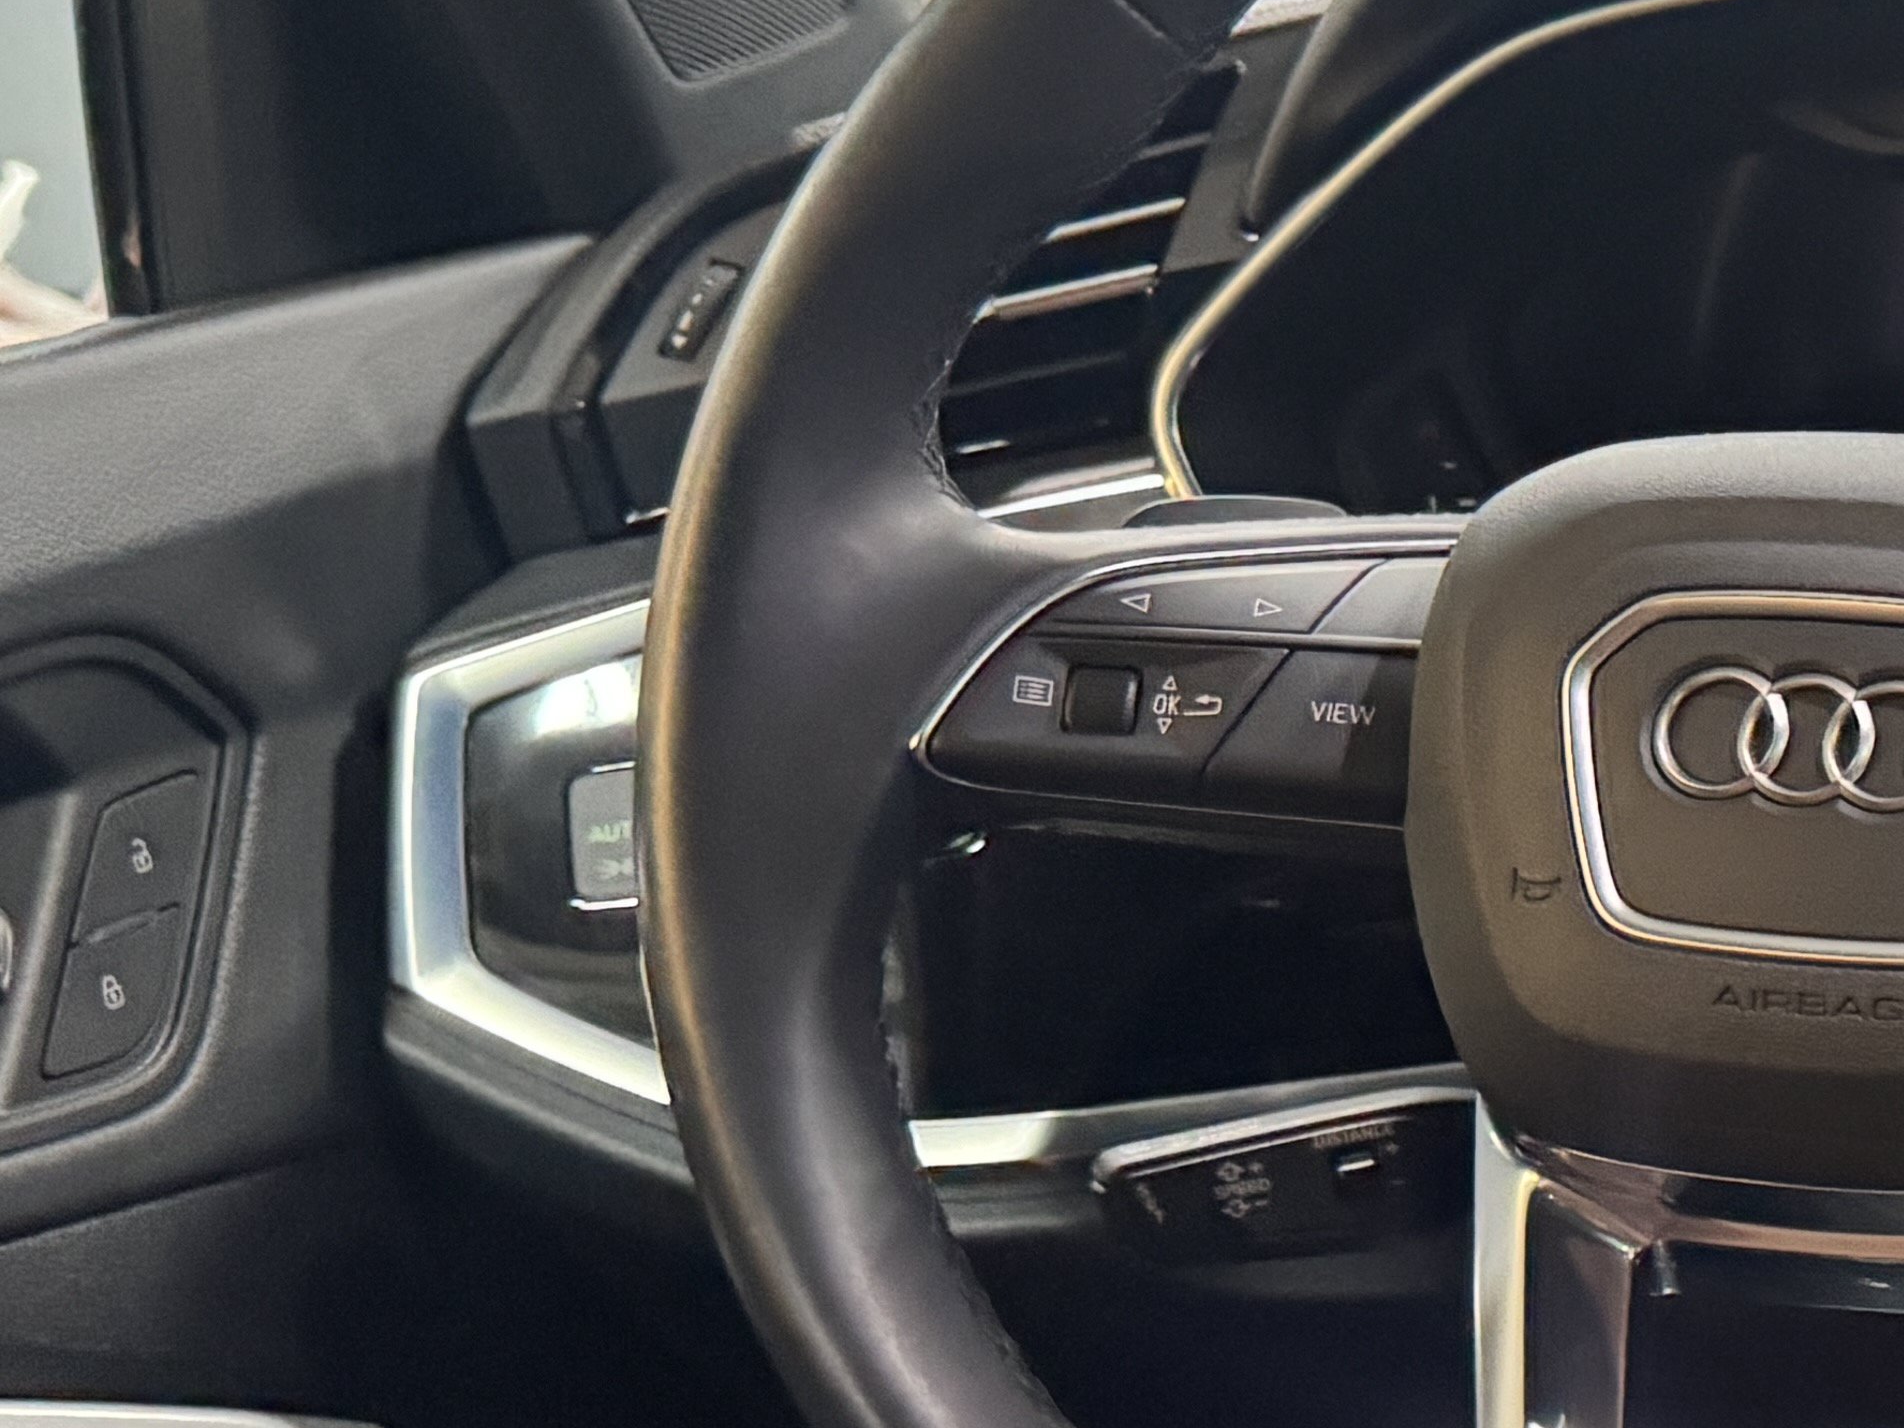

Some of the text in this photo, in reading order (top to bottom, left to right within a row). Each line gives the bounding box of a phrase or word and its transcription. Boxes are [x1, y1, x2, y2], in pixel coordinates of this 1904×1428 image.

[1152, 693, 1181, 716] OK
[1310, 700, 1376, 726] VIEW
[1711, 984, 1904, 1021] AIRBAG
